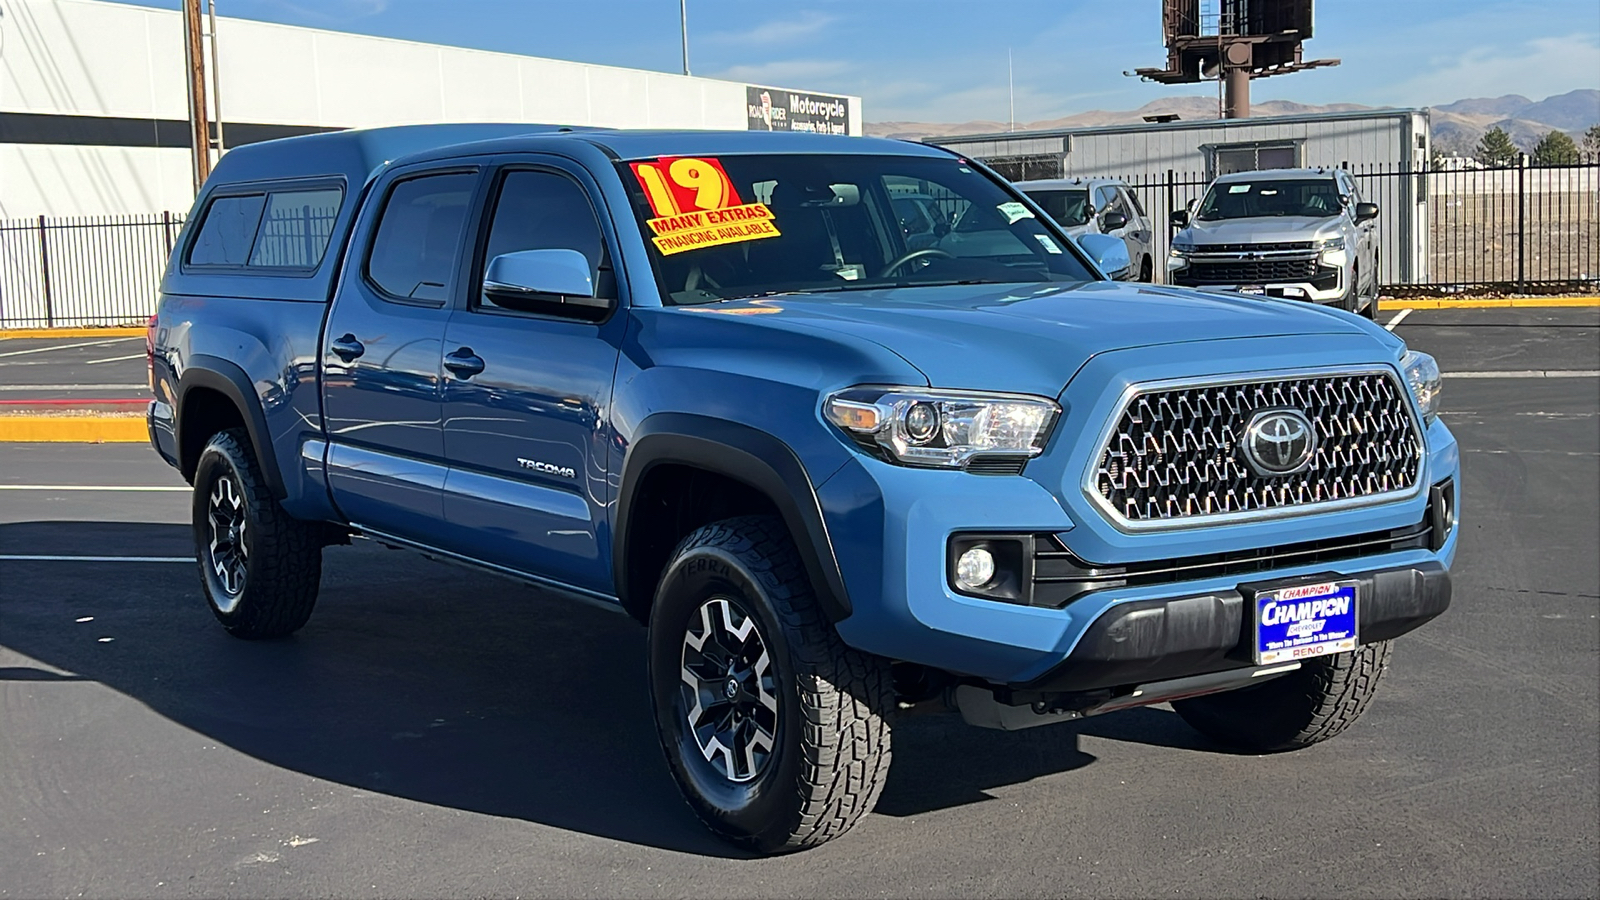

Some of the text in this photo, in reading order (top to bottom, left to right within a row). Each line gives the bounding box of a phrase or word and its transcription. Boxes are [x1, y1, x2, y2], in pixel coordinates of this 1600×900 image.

[790, 95, 845, 120] Motorcycle
[638, 158, 726, 216] 19
[652, 205, 768, 234] MANY EXTRAS
[657, 222, 774, 250] FINANCING AVAILABLE
[517, 457, 576, 478] TACOMA
[680, 558, 731, 581] TERRA
[1283, 585, 1331, 599] CHAMPION
[1262, 596, 1350, 626] CHAMPION
[1290, 622, 1323, 633] CHEVROLET
[1293, 645, 1324, 657] RENO
